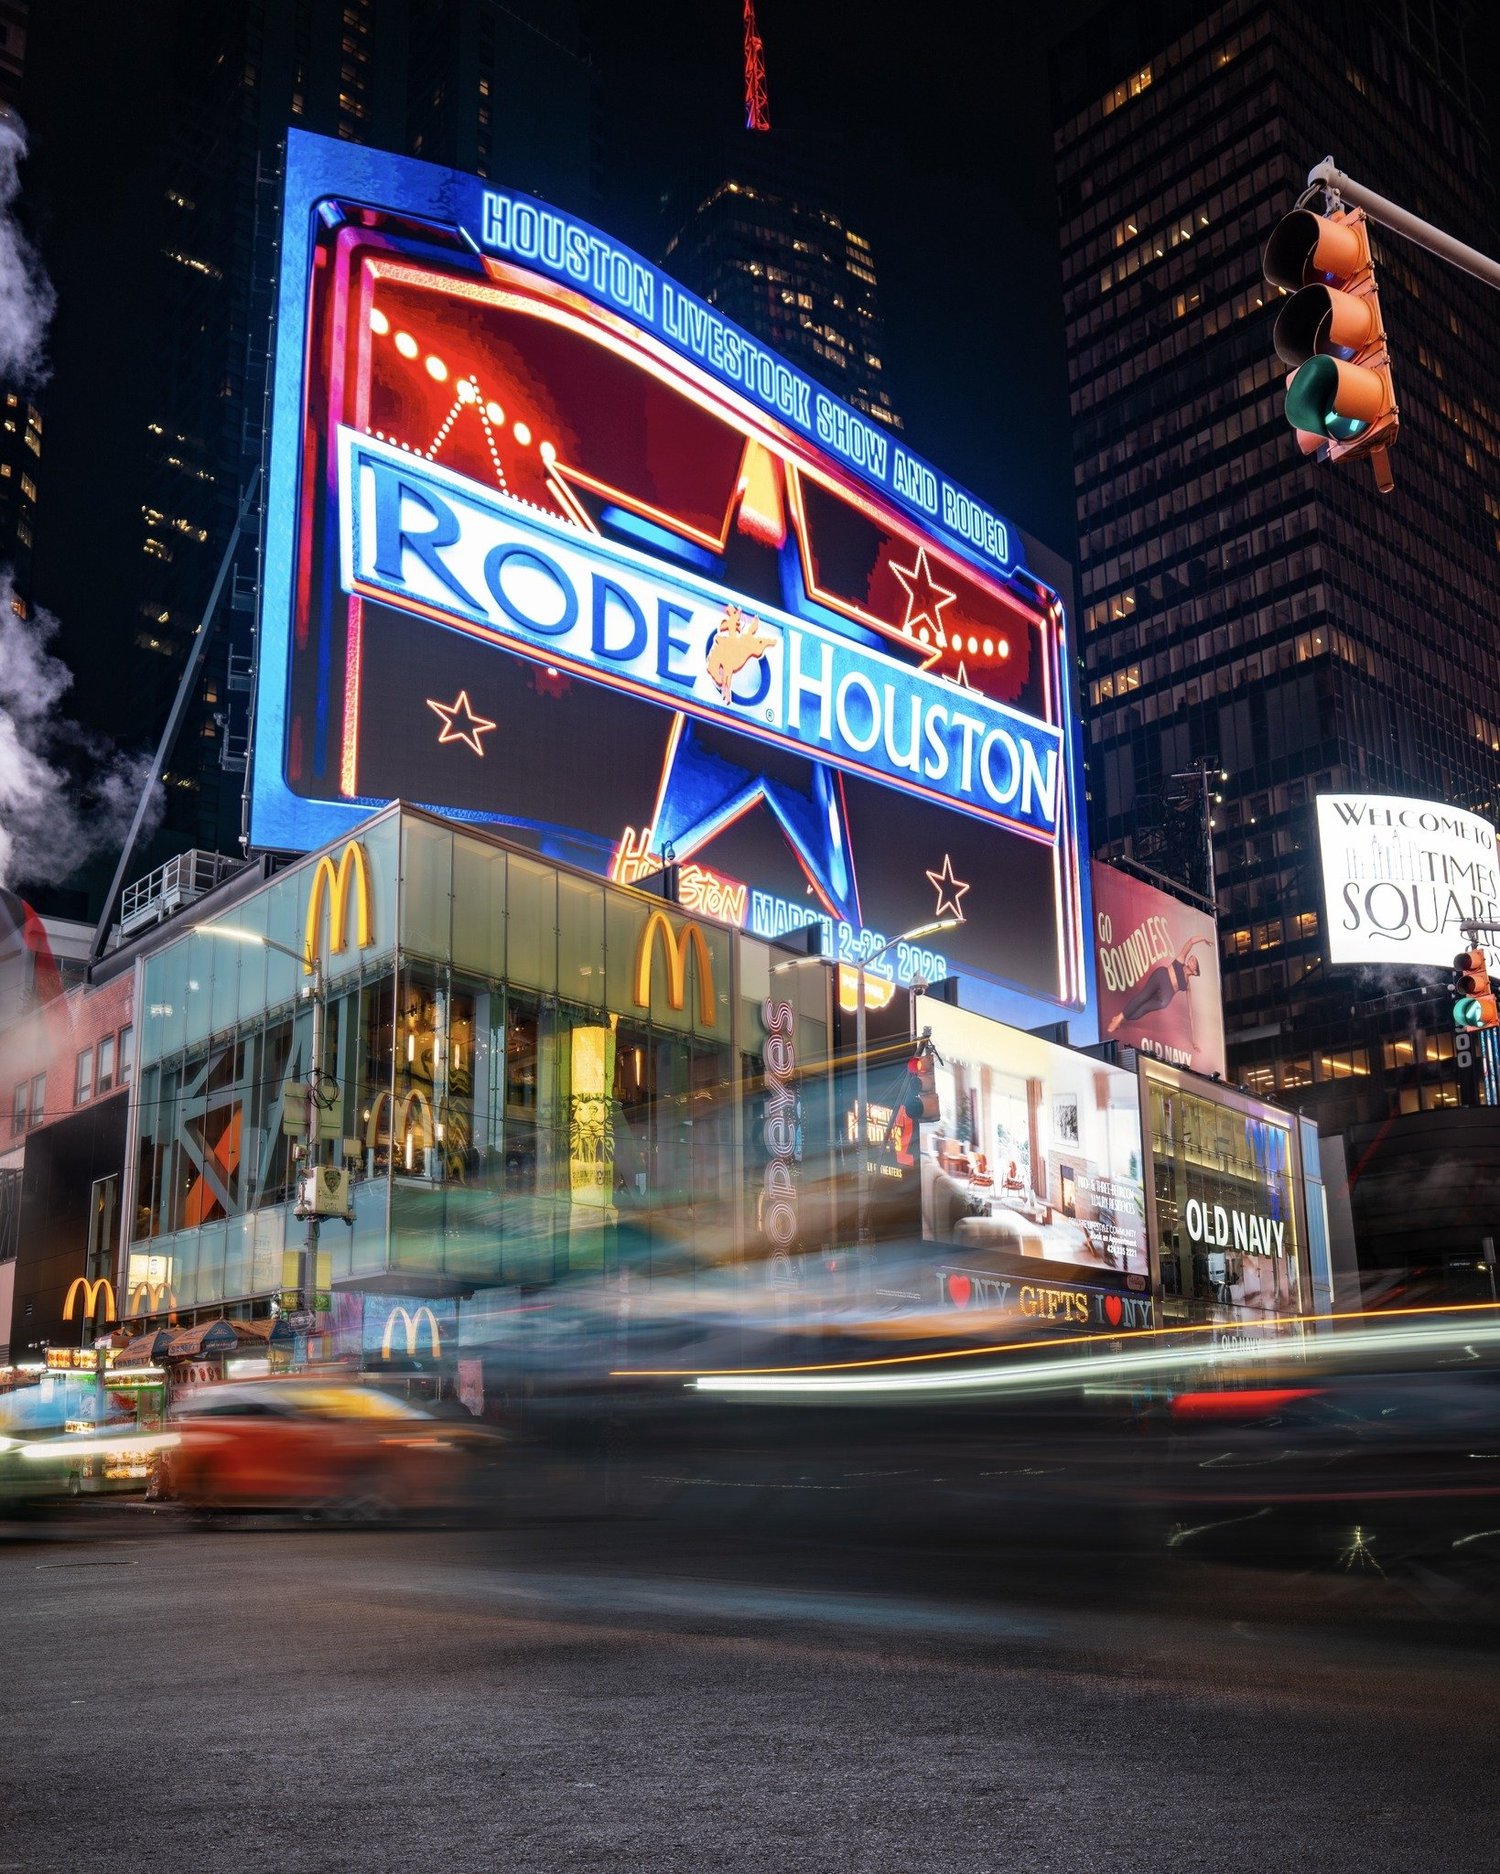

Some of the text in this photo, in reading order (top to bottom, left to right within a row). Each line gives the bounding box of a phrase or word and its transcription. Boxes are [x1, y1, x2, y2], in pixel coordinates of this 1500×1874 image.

[481, 191, 1009, 564] HOUSTON LIVESTOCK SHOW AND RODEO
[1333, 803, 1492, 850] WELCOME TO
[1421, 851, 1497, 900] TIMES
[1098, 912, 1112, 944] GO
[897, 943, 947, 984] 2026
[1100, 916, 1176, 991] BOUNDLESS
[1141, 1038, 1192, 1067] OLD NAVY
[1186, 1199, 1284, 1259] OLD NAVY
[1019, 1284, 1089, 1323] GIFTS
